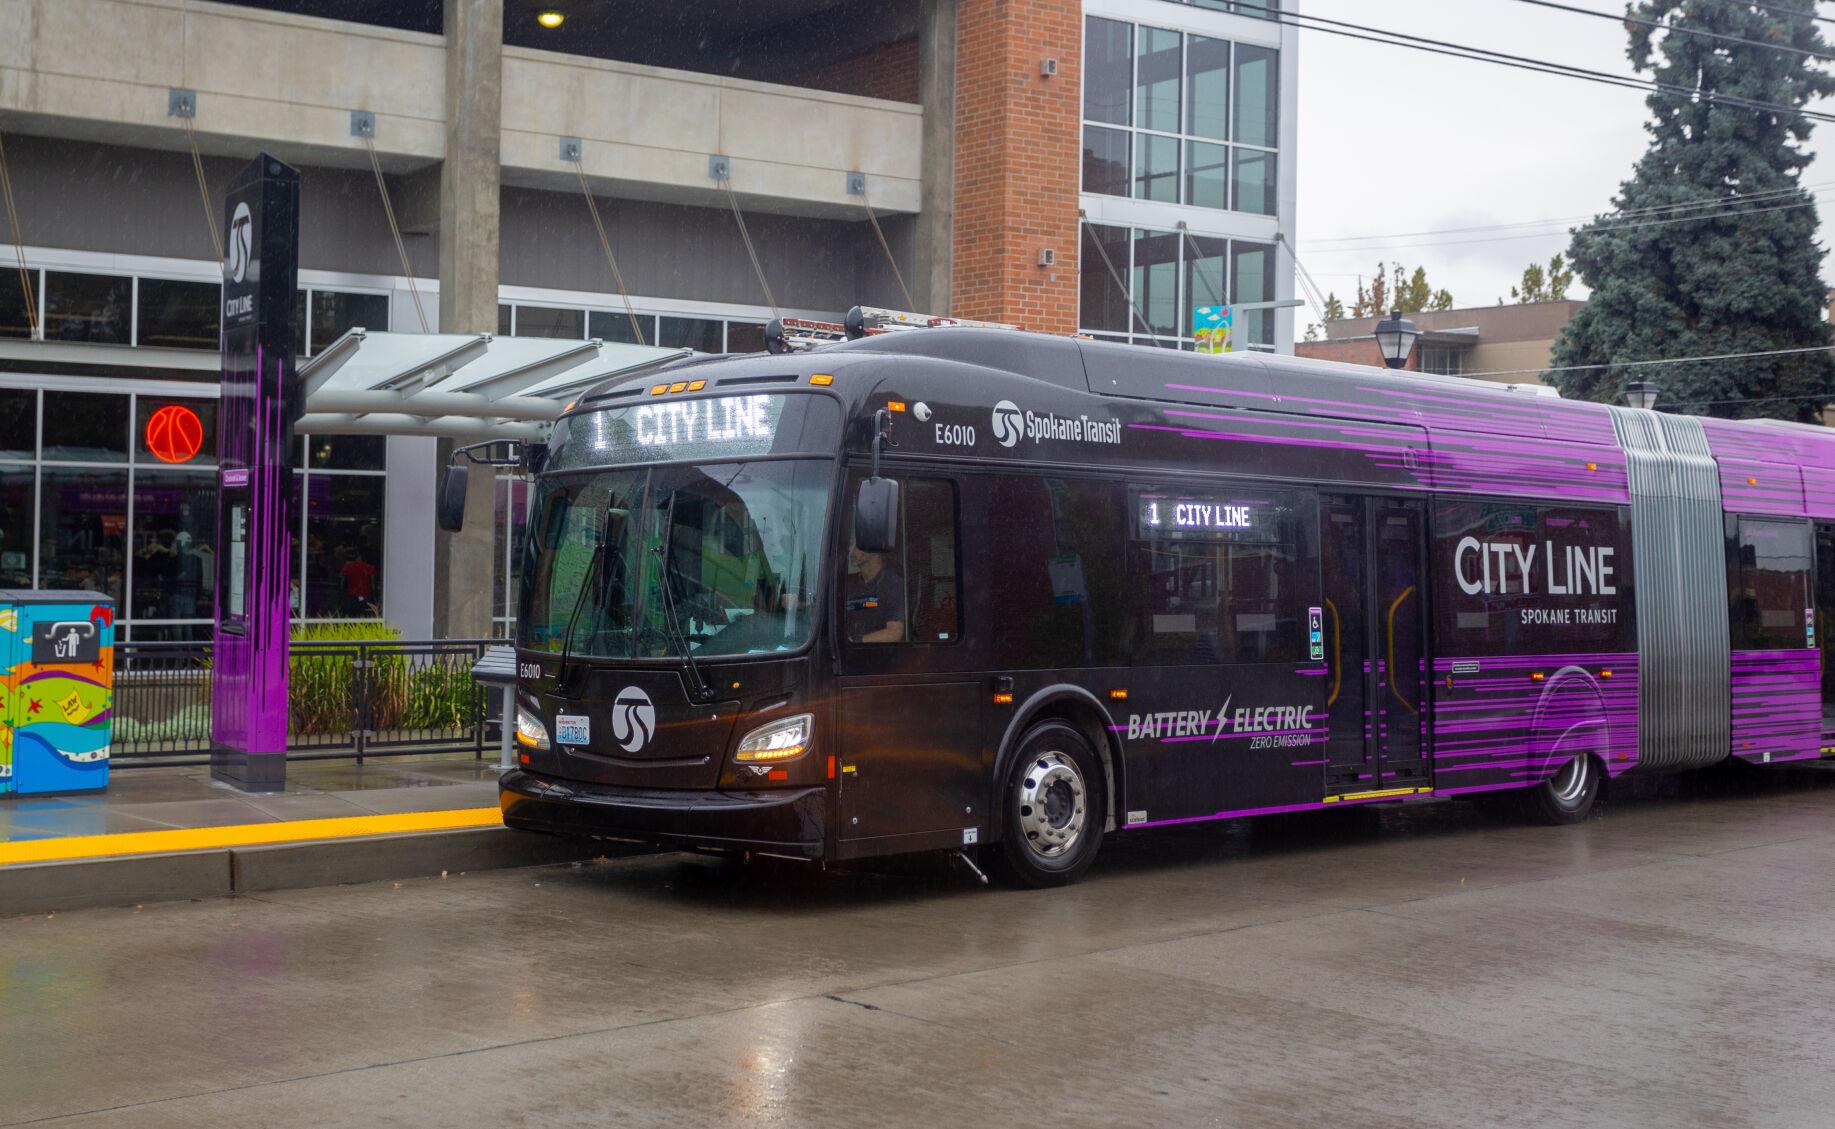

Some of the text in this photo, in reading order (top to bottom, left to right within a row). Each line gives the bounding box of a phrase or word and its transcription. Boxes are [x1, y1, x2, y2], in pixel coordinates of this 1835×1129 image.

[226, 294, 253, 317] CITY LINE
[593, 394, 770, 449] 1 CITY LINE
[1026, 409, 1122, 444] Spokane Transit
[935, 423, 976, 447] E6010
[1150, 503, 1251, 527] 1 CITY LINE
[1454, 536, 1617, 595] CITY LINE
[1521, 609, 1617, 625] SPOKANE TRANSIT
[520, 663, 541, 679] E6010
[1127, 705, 1313, 740] BATTERY ELECTRIC
[1250, 734, 1311, 750] ZERO EMISSION
